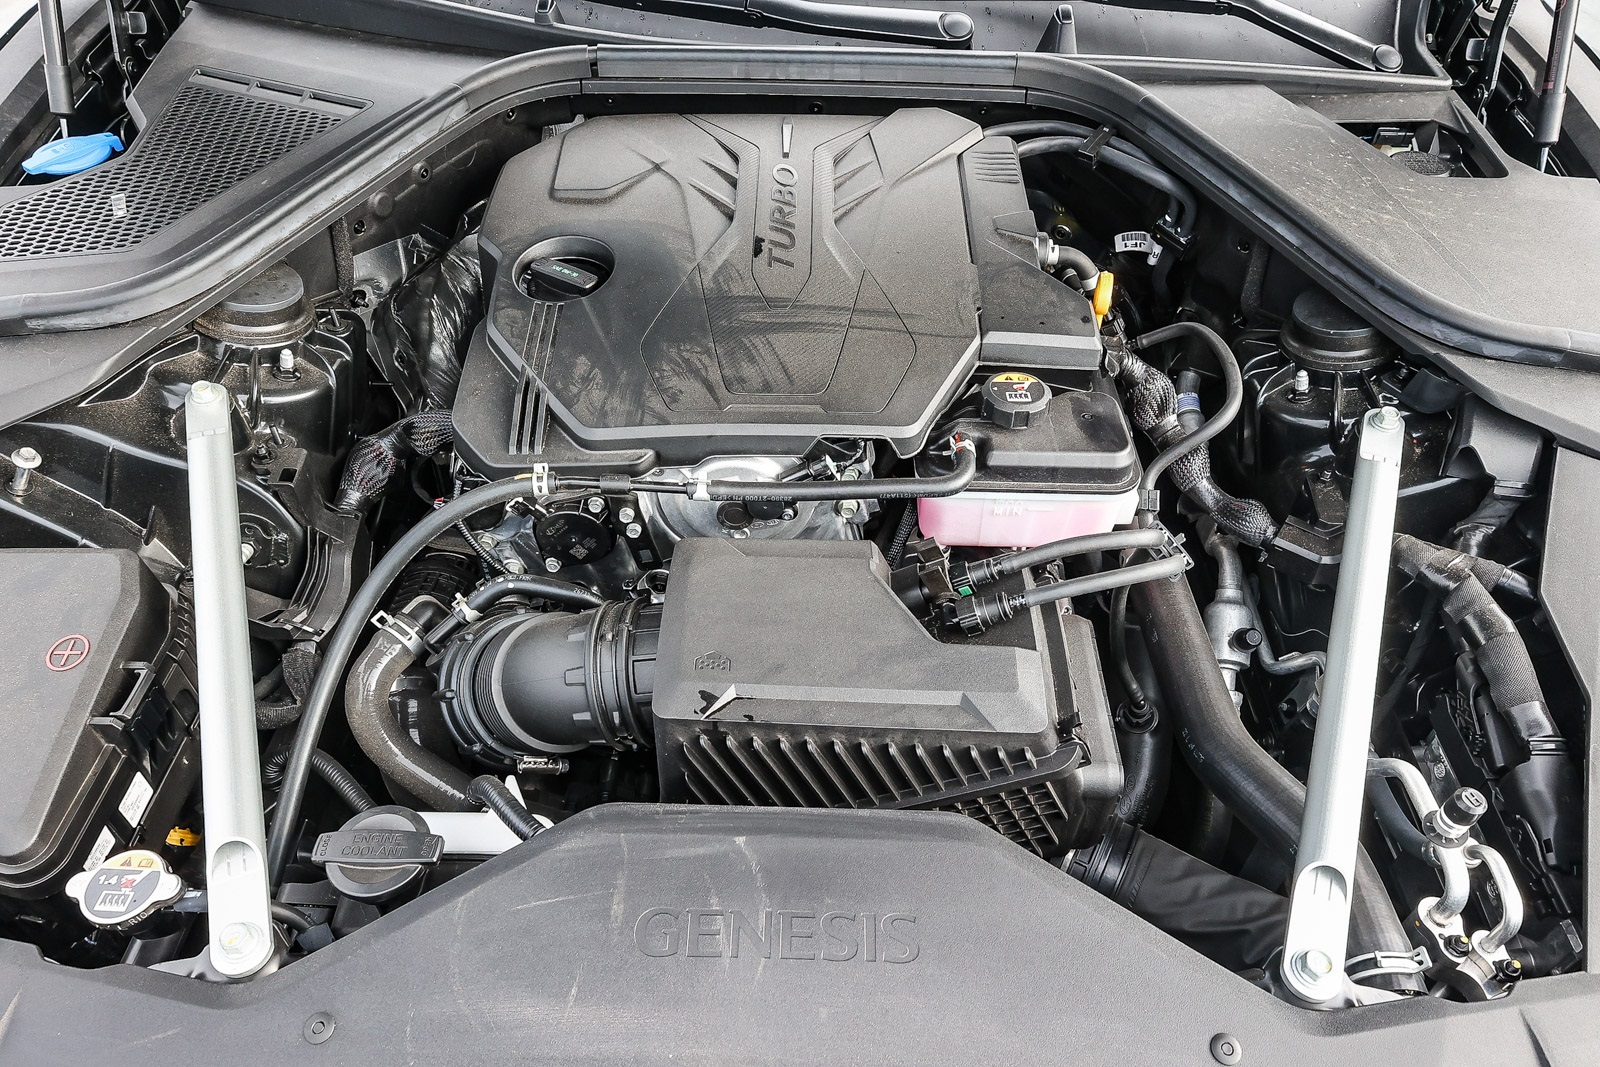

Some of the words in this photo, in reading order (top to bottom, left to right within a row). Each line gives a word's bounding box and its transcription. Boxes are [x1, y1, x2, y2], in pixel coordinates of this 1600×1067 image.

[767, 163, 799, 269] TURBO
[320, 834, 333, 857] CLOSE
[352, 832, 404, 844] ENGINE
[341, 845, 409, 857] COOLANT
[633, 907, 921, 964] GENESIS
